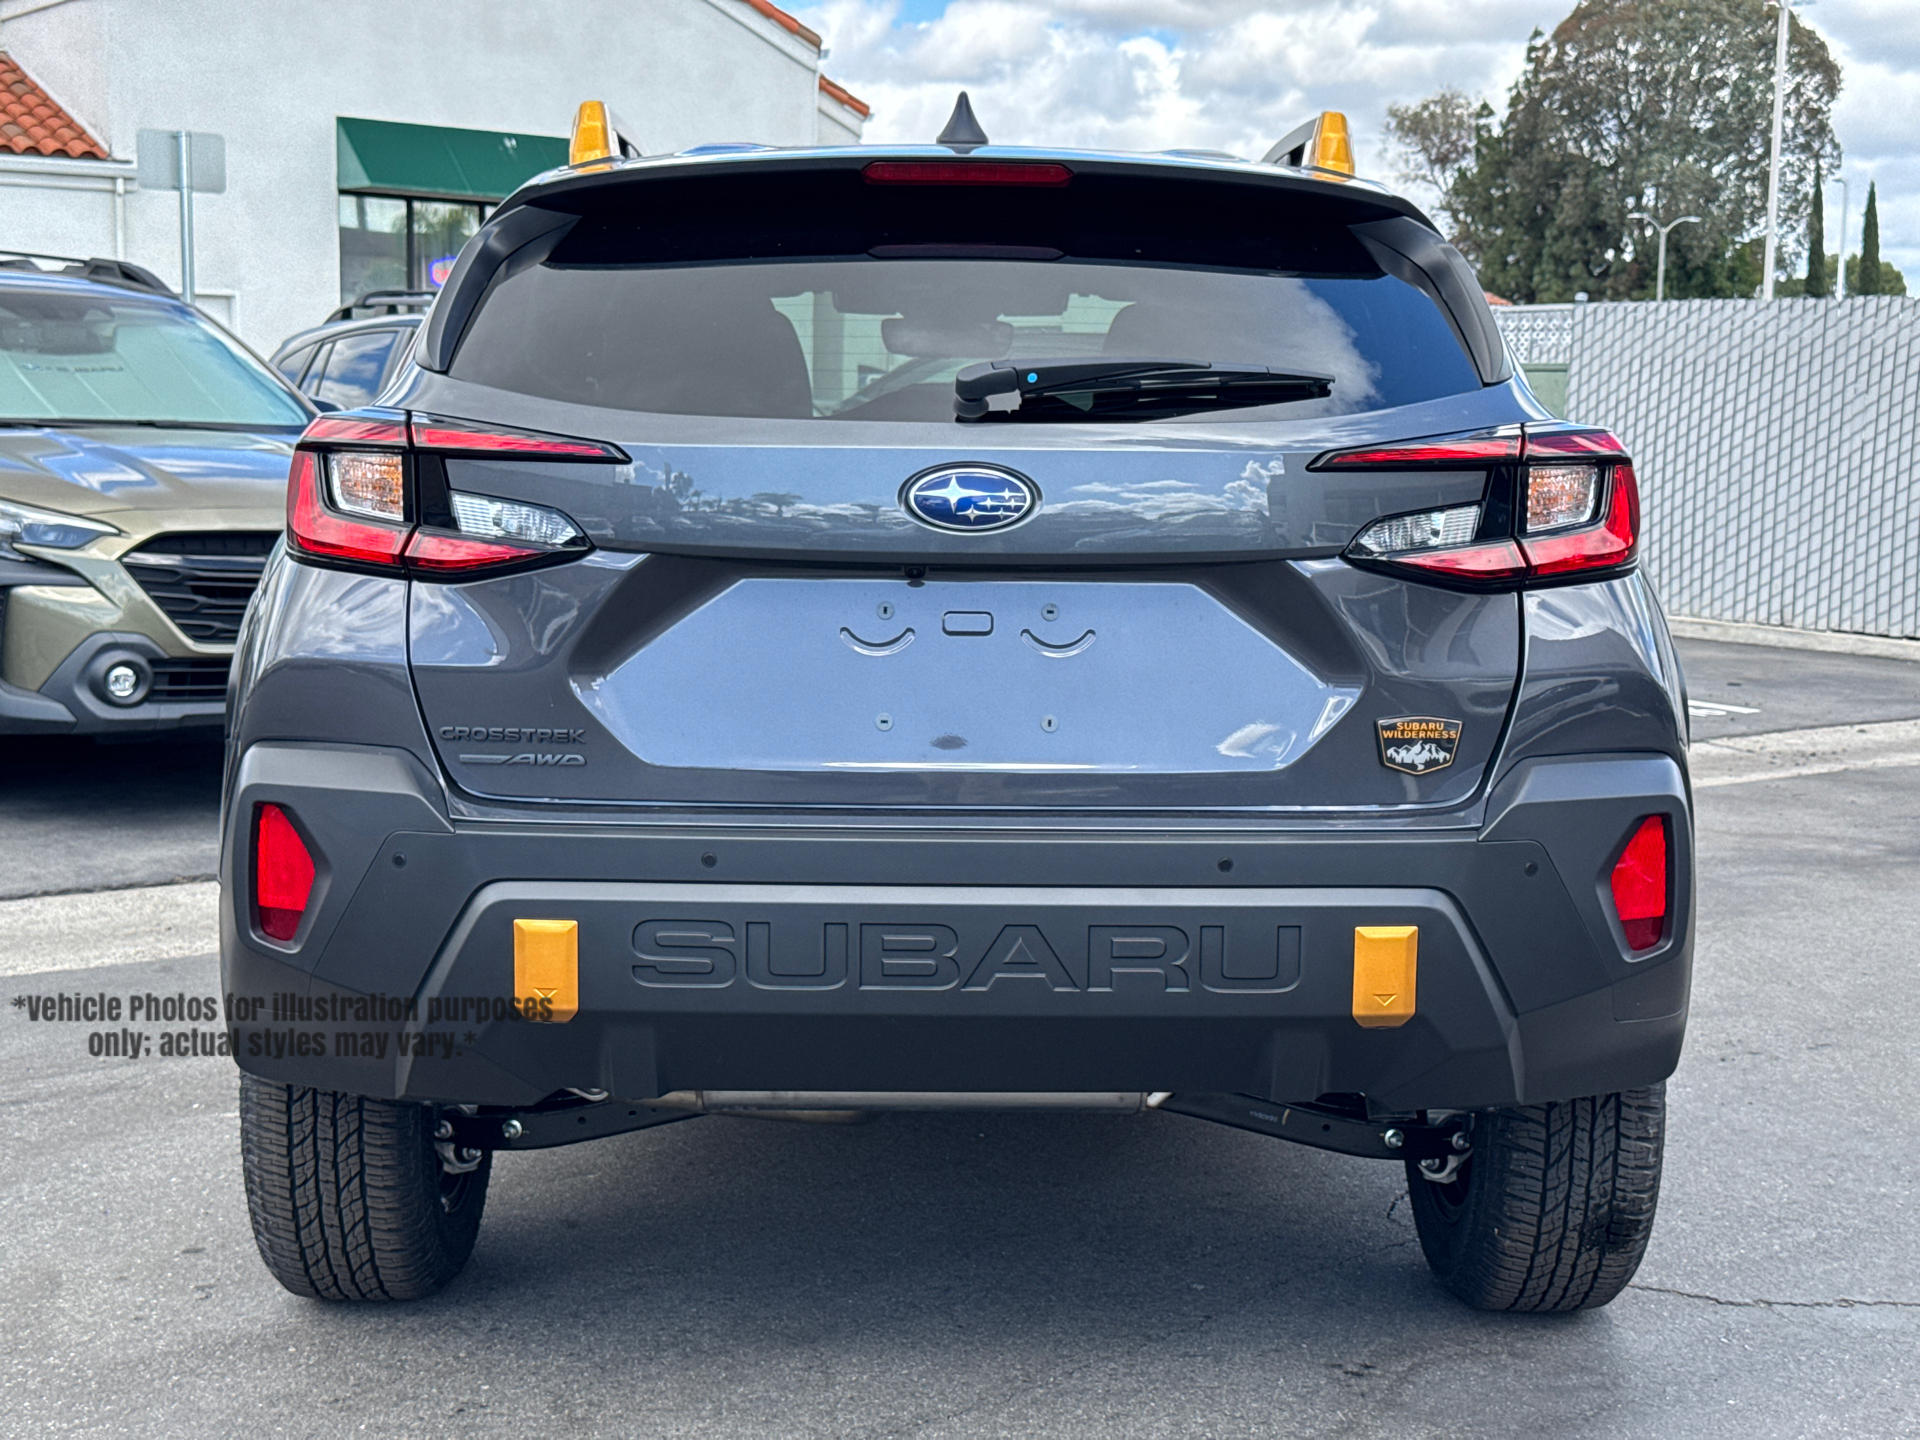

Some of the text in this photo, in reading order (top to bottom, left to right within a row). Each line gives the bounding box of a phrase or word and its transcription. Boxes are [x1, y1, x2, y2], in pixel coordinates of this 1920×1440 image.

[1396, 722, 1444, 731] SUBARU
[439, 726, 587, 744] CROSSTREK
[1382, 730, 1457, 739] WILDERNESS
[504, 753, 587, 766] AWD
[630, 918, 1302, 994] SUBARU
